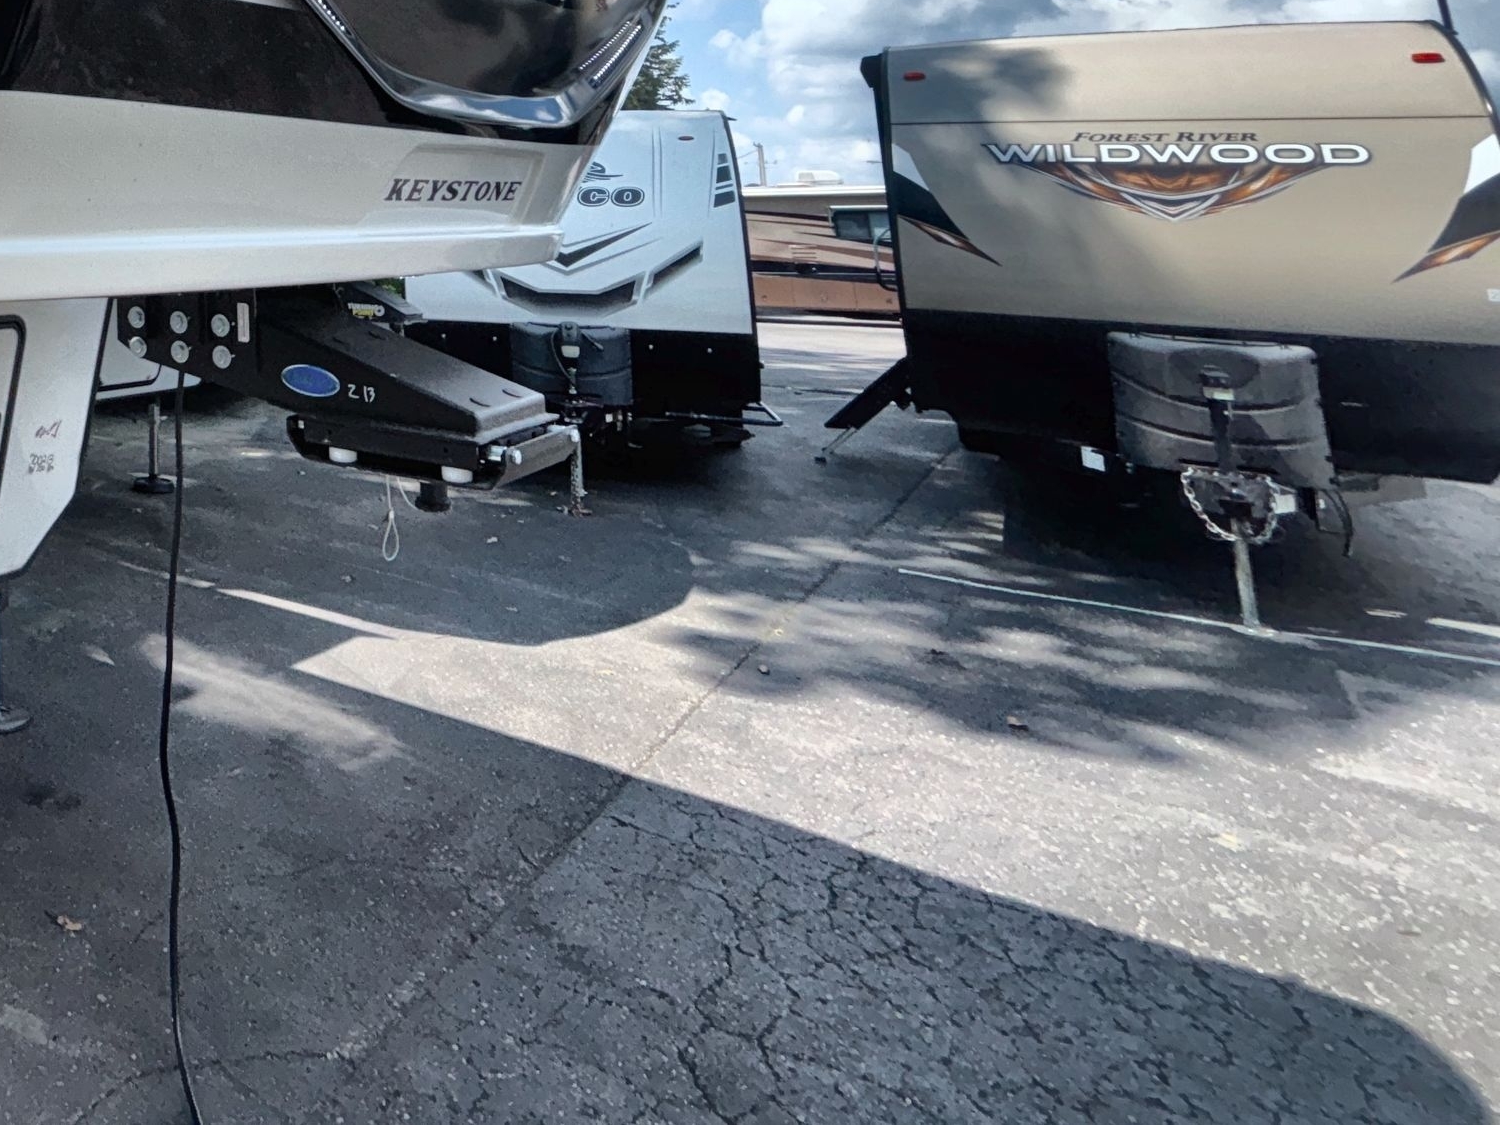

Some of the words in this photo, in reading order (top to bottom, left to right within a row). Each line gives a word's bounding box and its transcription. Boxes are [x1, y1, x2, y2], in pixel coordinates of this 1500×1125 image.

[982, 143, 1370, 166] WILDWOOD
[385, 178, 522, 201] KEYSTONE
[577, 186, 645, 207] CO
